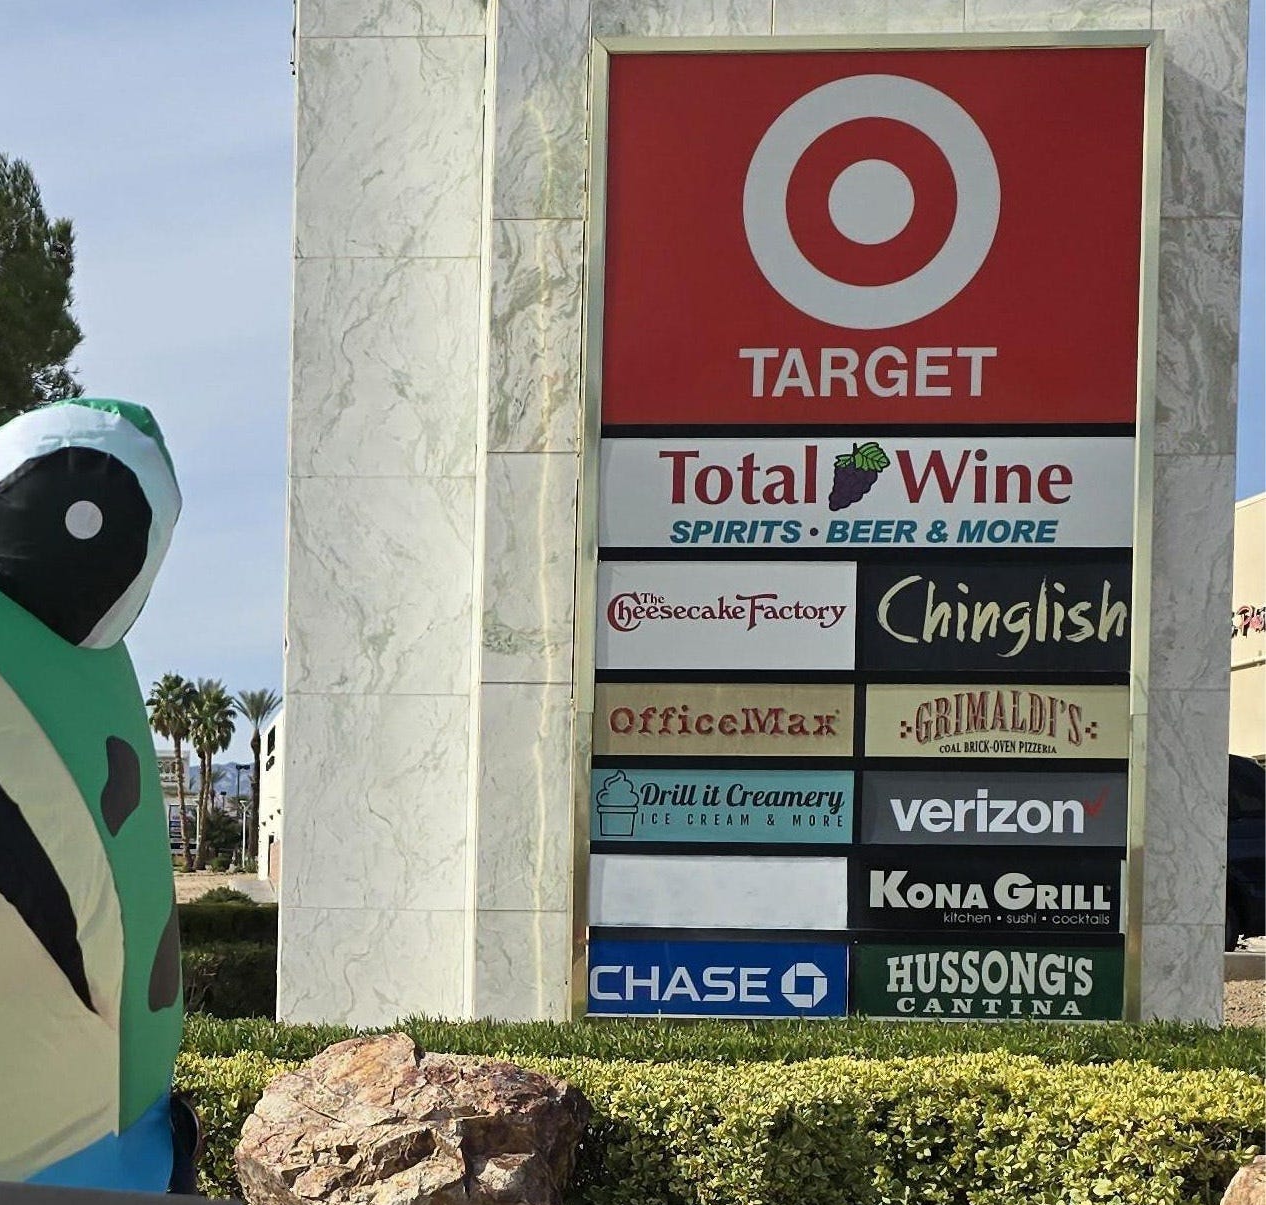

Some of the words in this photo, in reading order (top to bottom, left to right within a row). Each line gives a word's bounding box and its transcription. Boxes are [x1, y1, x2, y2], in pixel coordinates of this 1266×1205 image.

[739, 346, 997, 398] TARGET
[659, 445, 817, 504] Total
[896, 448, 1073, 504] Wine
[670, 520, 802, 544] SPIRITS
[826, 520, 917, 544] BEER
[926, 520, 948, 544] &
[957, 520, 1058, 544] MORE
[607, 591, 746, 632] Cheesecake
[736, 594, 847, 631] Factory
[639, 592, 665, 604] The
[877, 575, 1127, 657] Chinglish
[609, 704, 838, 736] OfficeMax
[915, 690, 1083, 747] GRIMALDI'S
[939, 744, 961, 754] COAL
[964, 740, 1016, 754] BRICK-OVEN
[1019, 741, 1057, 754] PIZZERIA
[640, 782, 698, 807] Drill
[704, 784, 721, 807] it
[726, 783, 845, 814] Creamery
[890, 788, 1084, 834] verizon
[641, 813, 671, 825] ICE
[687, 813, 749, 826] CREAM
[766, 814, 776, 826] &
[792, 814, 844, 827] MORE
[870, 870, 988, 909] KONA
[993, 872, 1111, 911] GRILL
[943, 912, 991, 924] kitchen
[1006, 912, 1036, 925] sushi
[1052, 913, 1110, 925] cocktails
[589, 965, 772, 1002] CHASE
[886, 950, 1093, 996] HUSSONG'S
[896, 997, 1082, 1016] CANTINA
